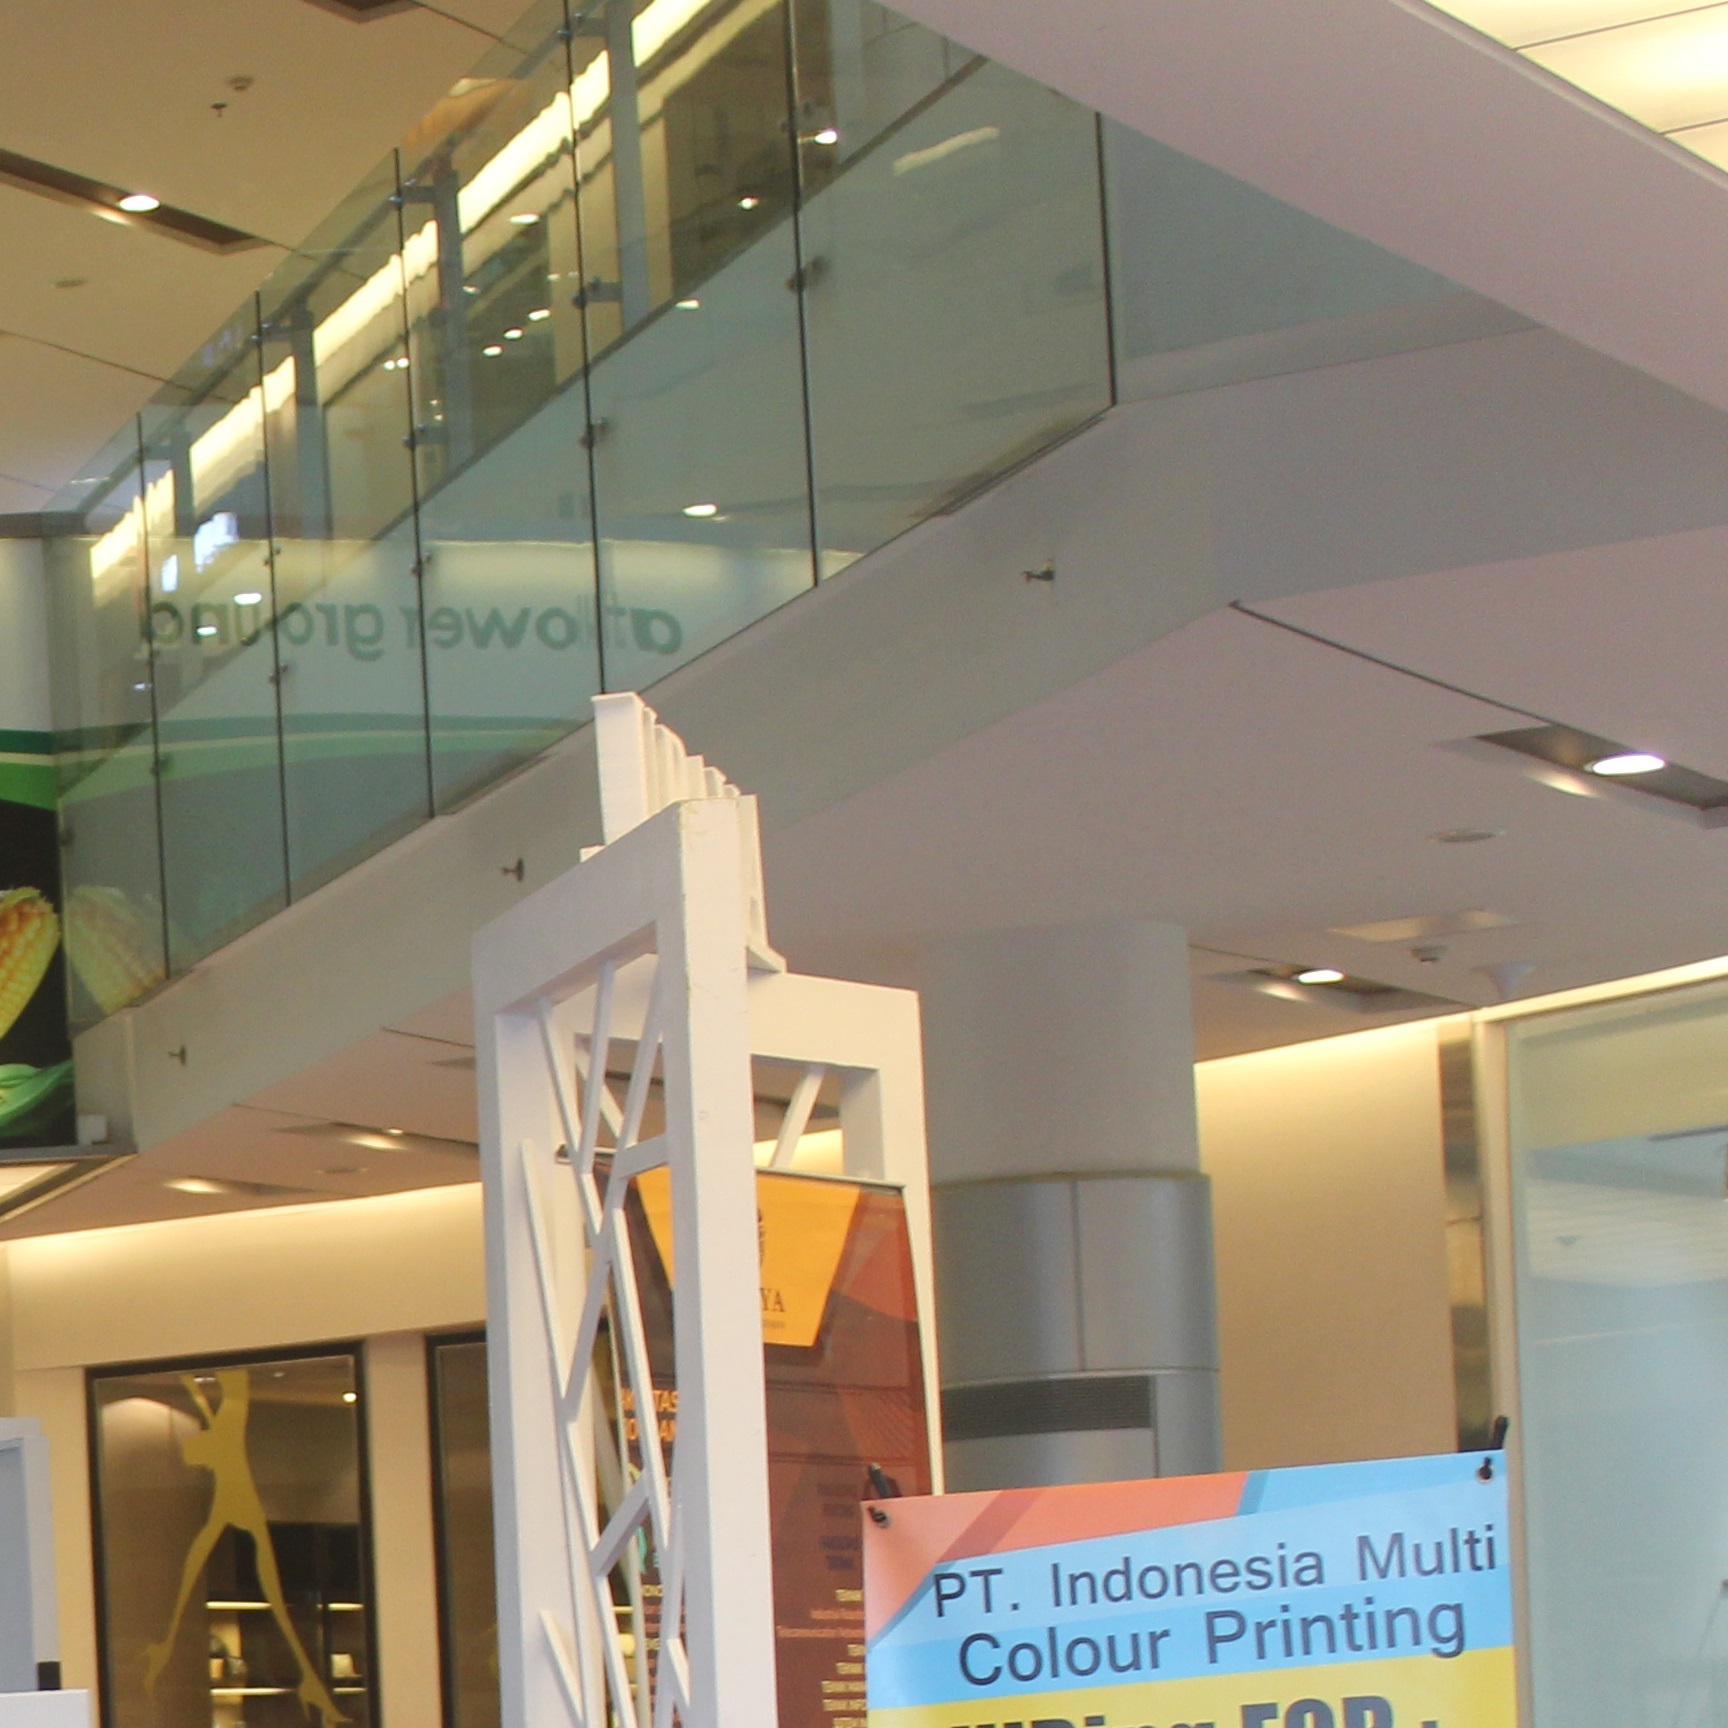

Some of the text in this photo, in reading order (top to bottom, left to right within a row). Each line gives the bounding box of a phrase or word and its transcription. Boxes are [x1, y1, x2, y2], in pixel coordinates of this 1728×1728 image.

[934, 1569, 1020, 1619] PT.
[1052, 1543, 1323, 1607] Indonesia
[1358, 1524, 1496, 1580] Multi
[958, 1597, 1465, 1686] Colour Printing
